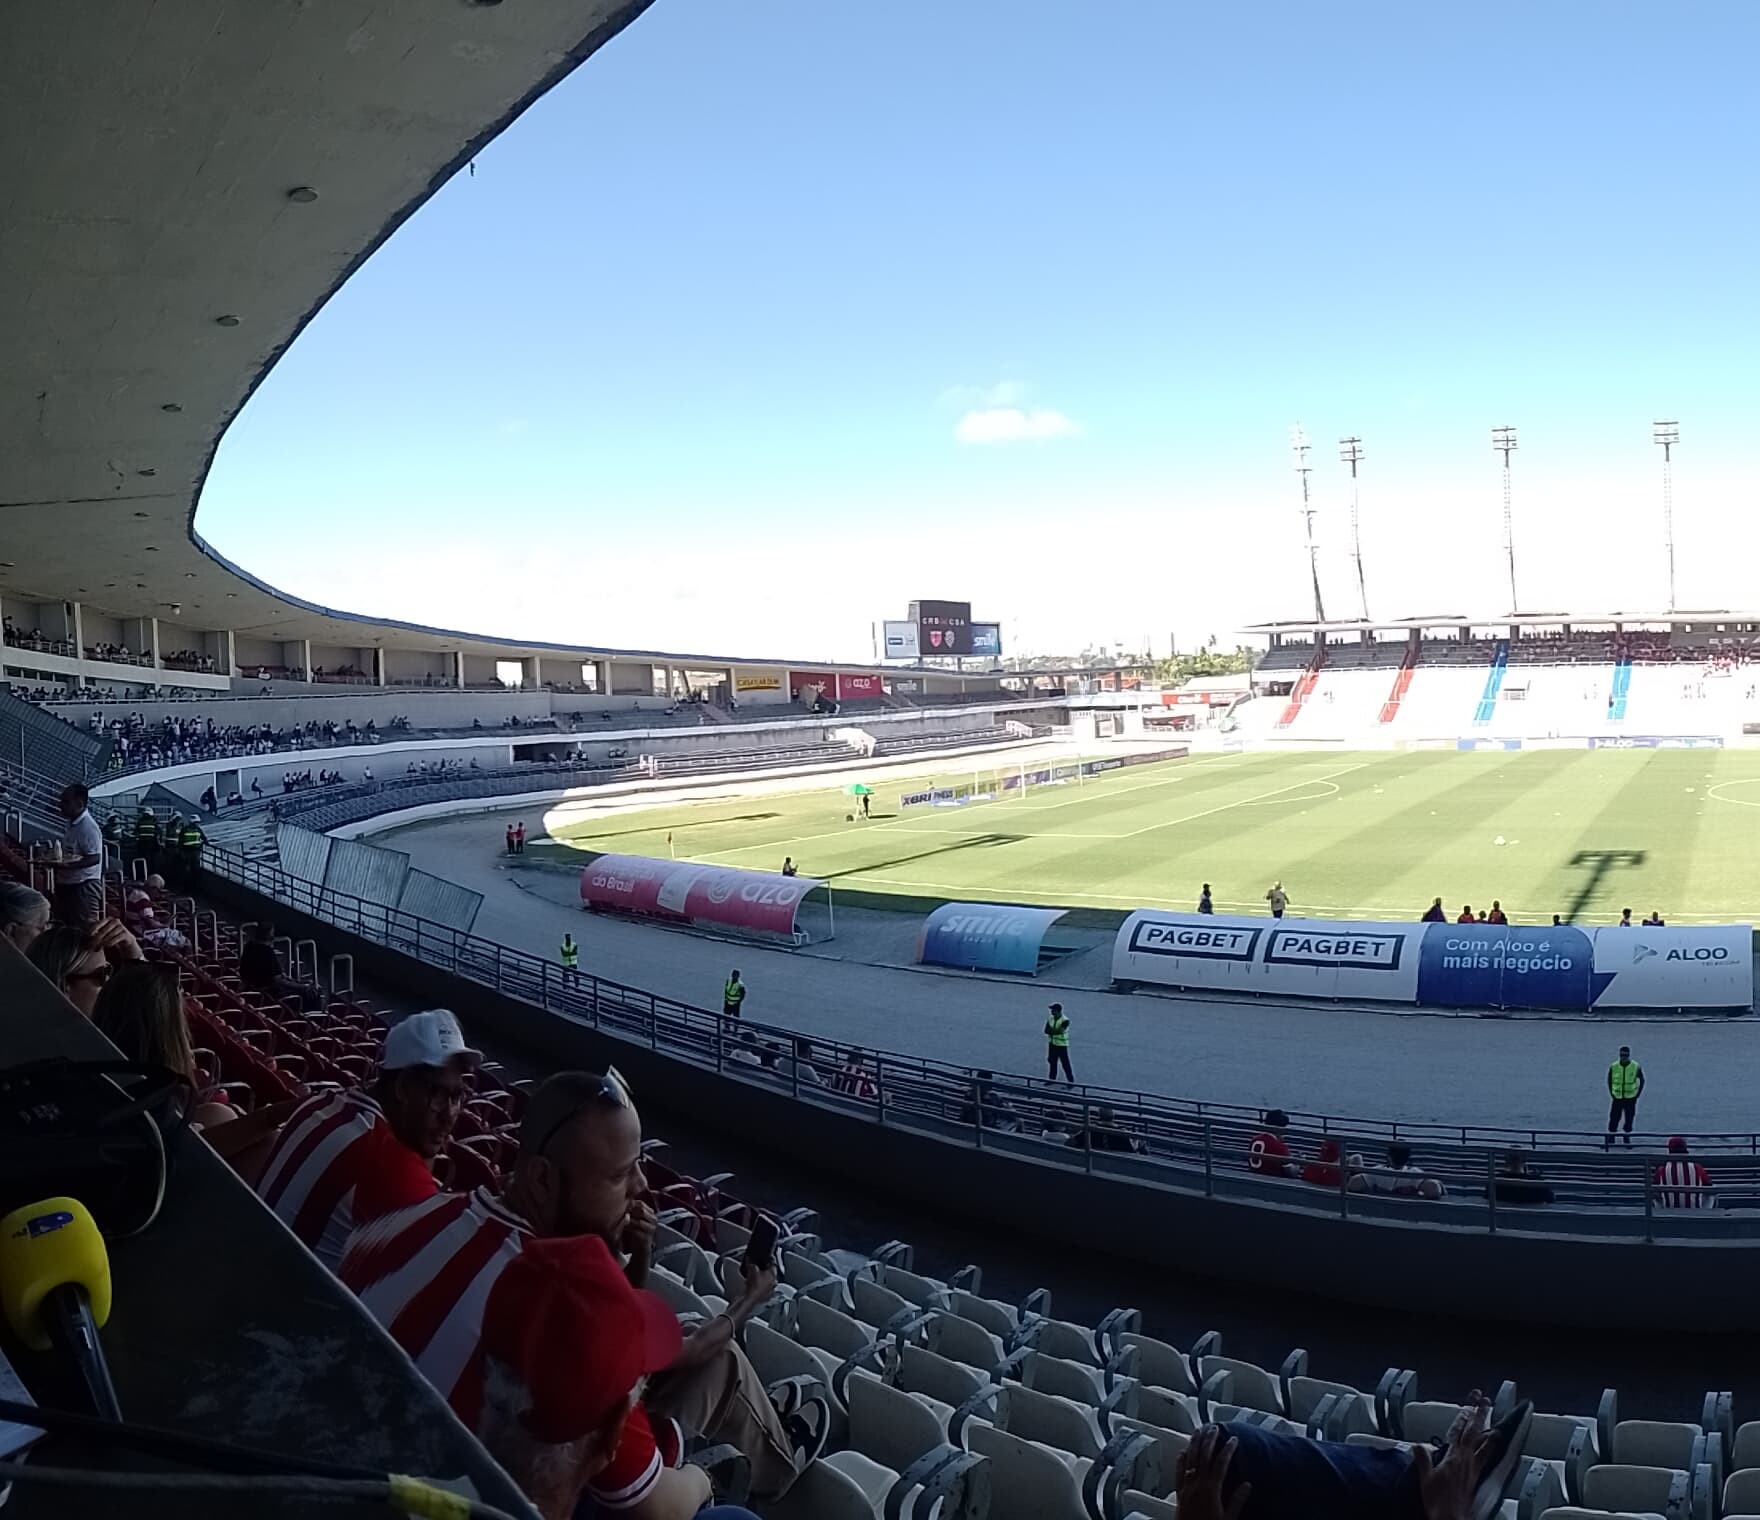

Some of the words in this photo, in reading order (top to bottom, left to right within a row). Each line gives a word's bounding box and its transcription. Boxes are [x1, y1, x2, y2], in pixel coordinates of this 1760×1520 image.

[939, 914, 1027, 936] smile
[1147, 928, 1244, 949] PAGBET
[1281, 937, 1386, 957] PAGBET
[1445, 938, 1488, 951] Com
[1491, 939, 1533, 952] Aloo
[1538, 941, 1551, 951] é
[1443, 953, 1489, 970] mais
[1493, 953, 1573, 973] negócio
[1664, 947, 1729, 961] ALOO
